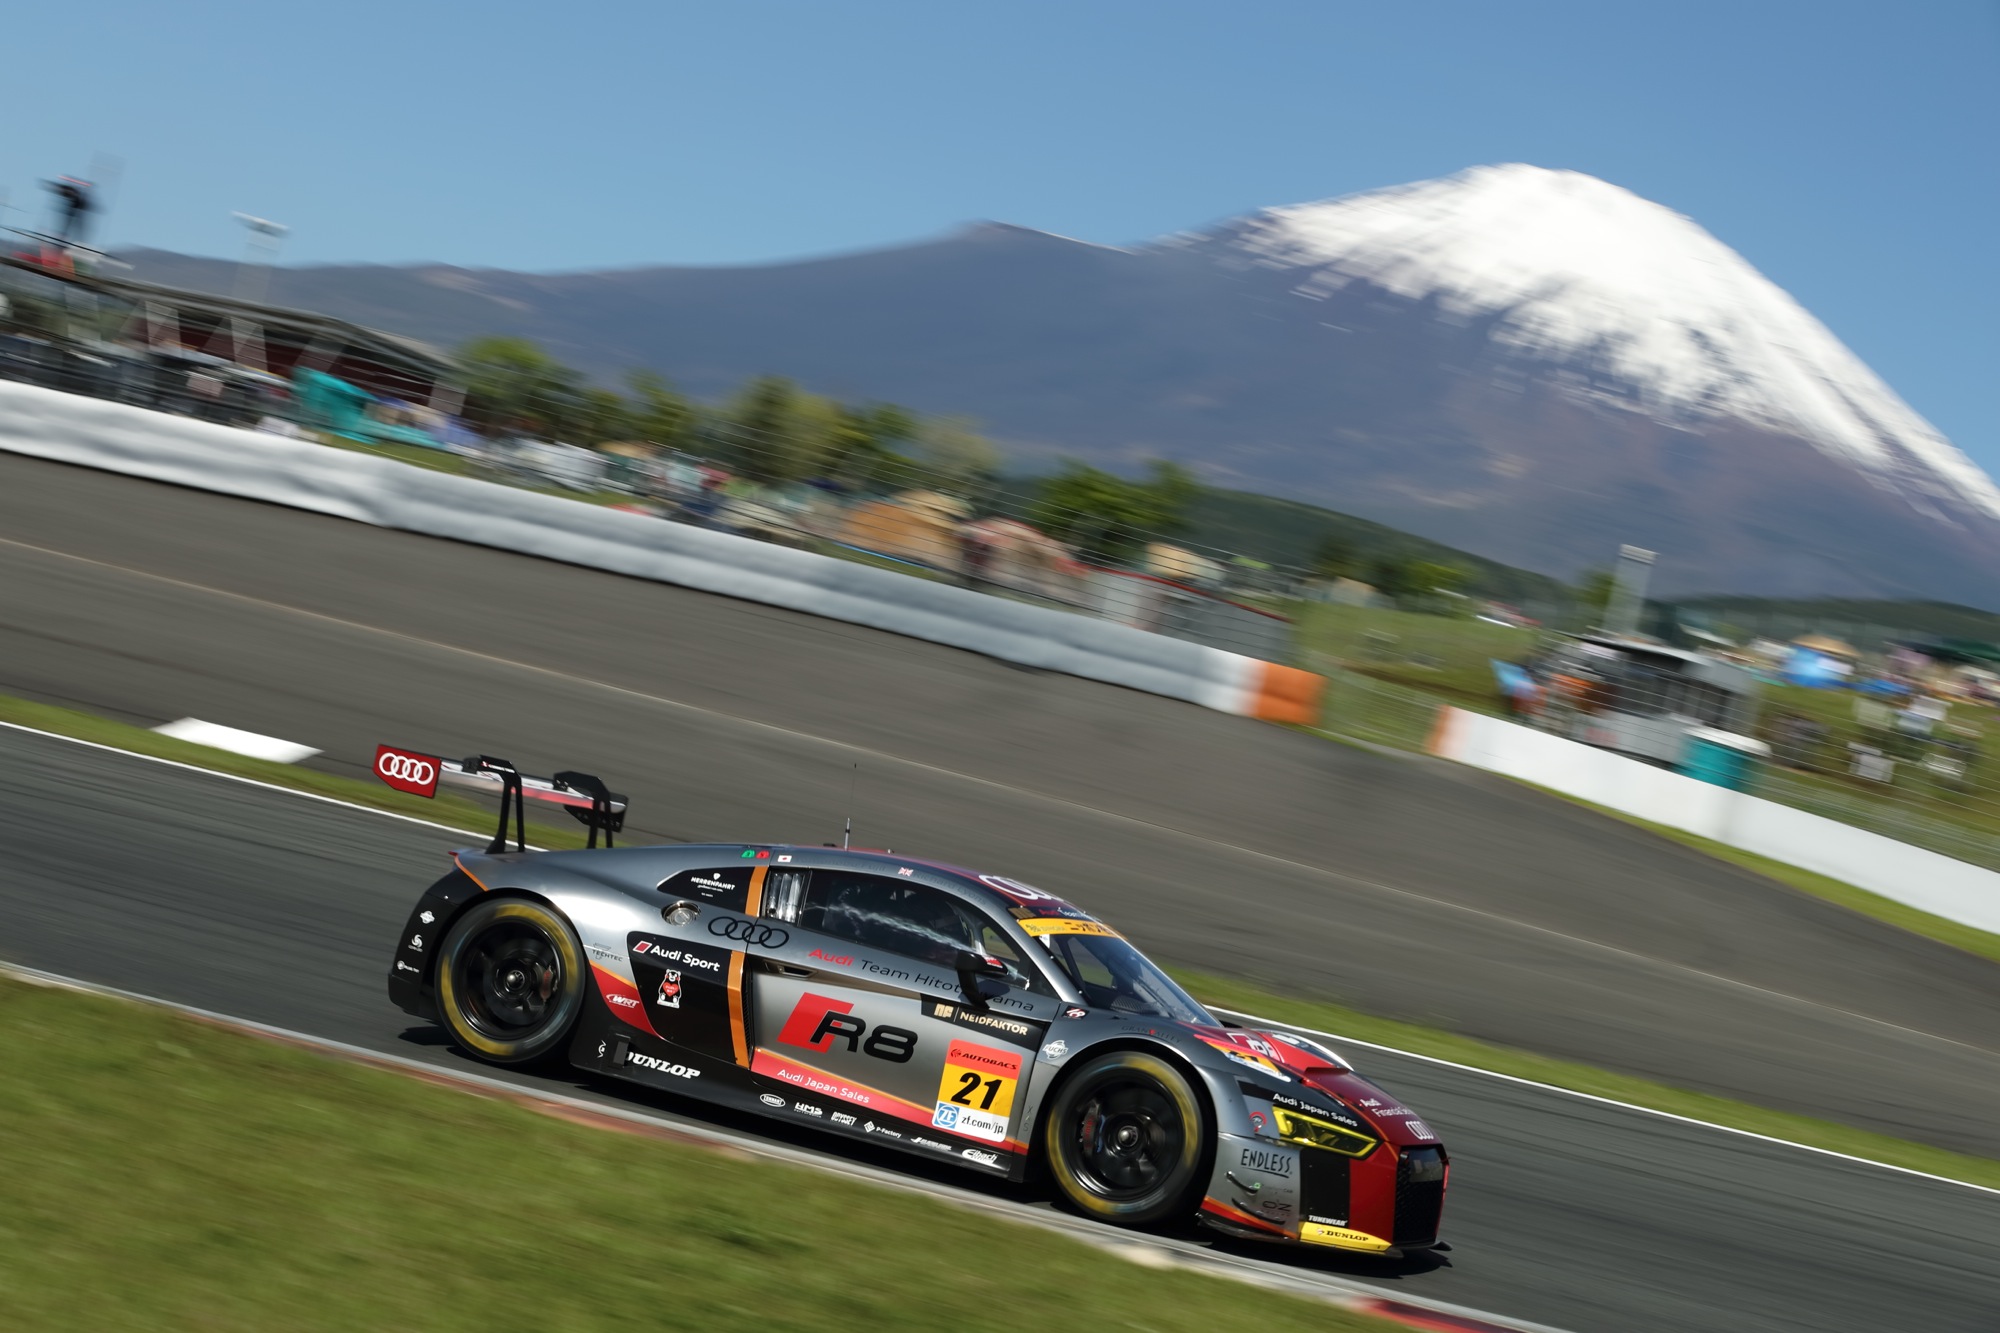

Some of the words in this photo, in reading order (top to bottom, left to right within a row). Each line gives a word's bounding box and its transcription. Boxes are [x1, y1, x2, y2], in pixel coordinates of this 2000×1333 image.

[650, 945, 681, 961] Audi
[682, 953, 720, 972] Sport
[808, 948, 855, 967] Audi
[861, 959, 909, 980] Team
[960, 1011, 1028, 1035] NEIDFAKTOR
[809, 1010, 918, 1063] R8
[962, 1052, 1018, 1070] AUTOBACS
[777, 1069, 804, 1083] Audi
[805, 1077, 838, 1094] Japan
[839, 1087, 870, 1104] Sales
[950, 1072, 1002, 1110] 21
[938, 1109, 956, 1122] ZF
[1273, 1093, 1298, 1107] Audi
[1300, 1101, 1330, 1118] Japan
[1331, 1112, 1358, 1127] Sales
[961, 1115, 1004, 1135] zf.com/jp
[1240, 1148, 1292, 1173] ENDLESS
[1326, 1230, 1369, 1242] DUNLOP
